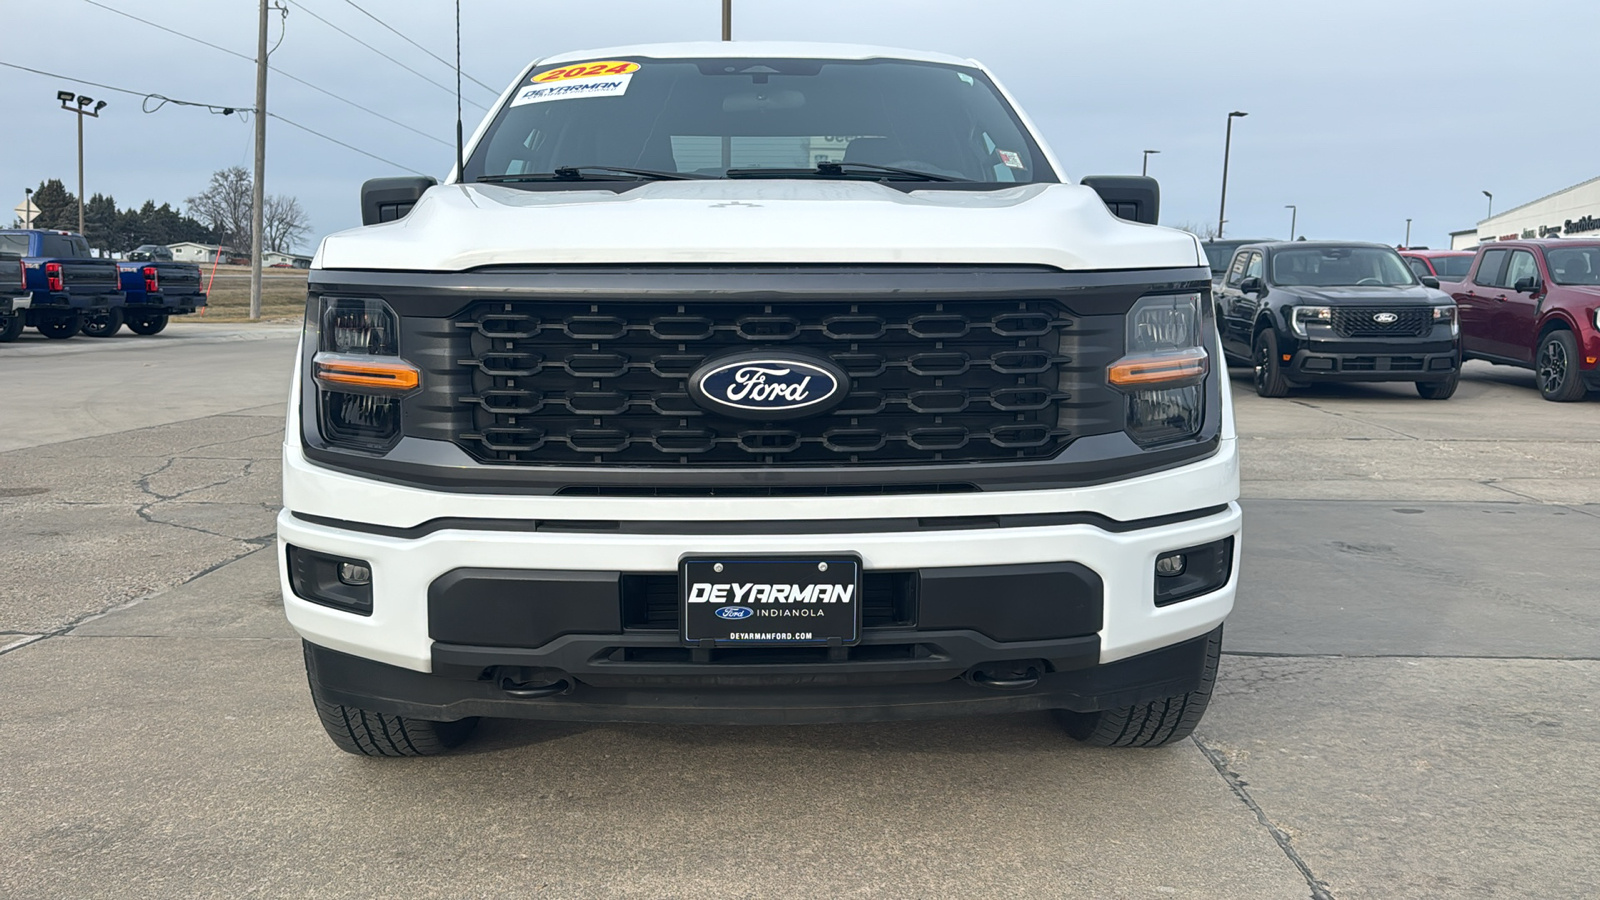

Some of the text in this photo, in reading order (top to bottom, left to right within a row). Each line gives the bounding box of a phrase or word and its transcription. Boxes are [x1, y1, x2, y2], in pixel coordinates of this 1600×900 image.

[540, 63, 632, 81] 2024
[522, 81, 623, 98] DEYARMAN
[726, 367, 812, 401] Ford
[688, 583, 854, 604] DEYARMAN
[722, 608, 825, 618] Ford INDIANOLA
[730, 632, 813, 640] DEYARMANFORD.COM
